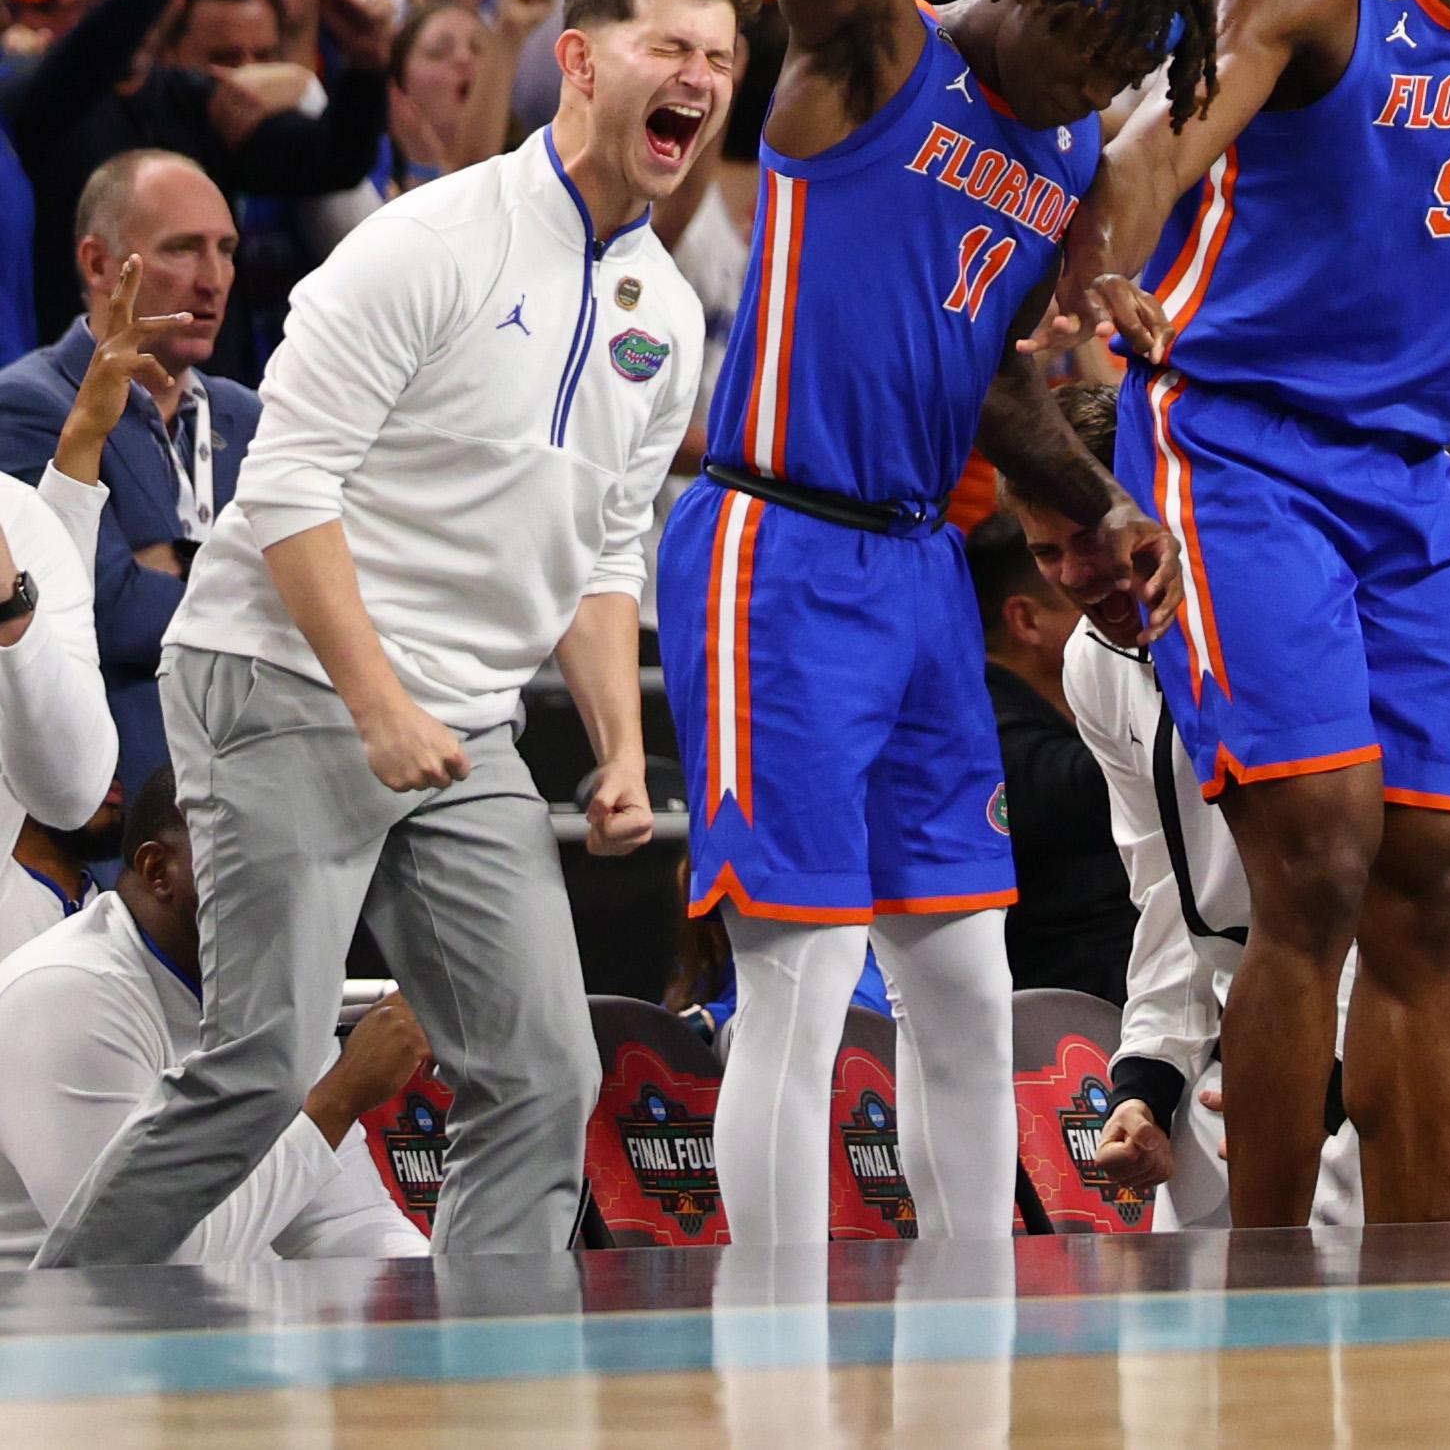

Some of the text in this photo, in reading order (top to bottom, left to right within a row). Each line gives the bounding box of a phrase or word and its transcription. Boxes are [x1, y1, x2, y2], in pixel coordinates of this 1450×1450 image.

[942, 224, 1017, 324] 11
[626, 1136, 716, 1171] FINAL FOU
[848, 1144, 898, 1177] FINAL
[1066, 1129, 1102, 1161] FIN
[391, 1149, 444, 1183] FINAL
